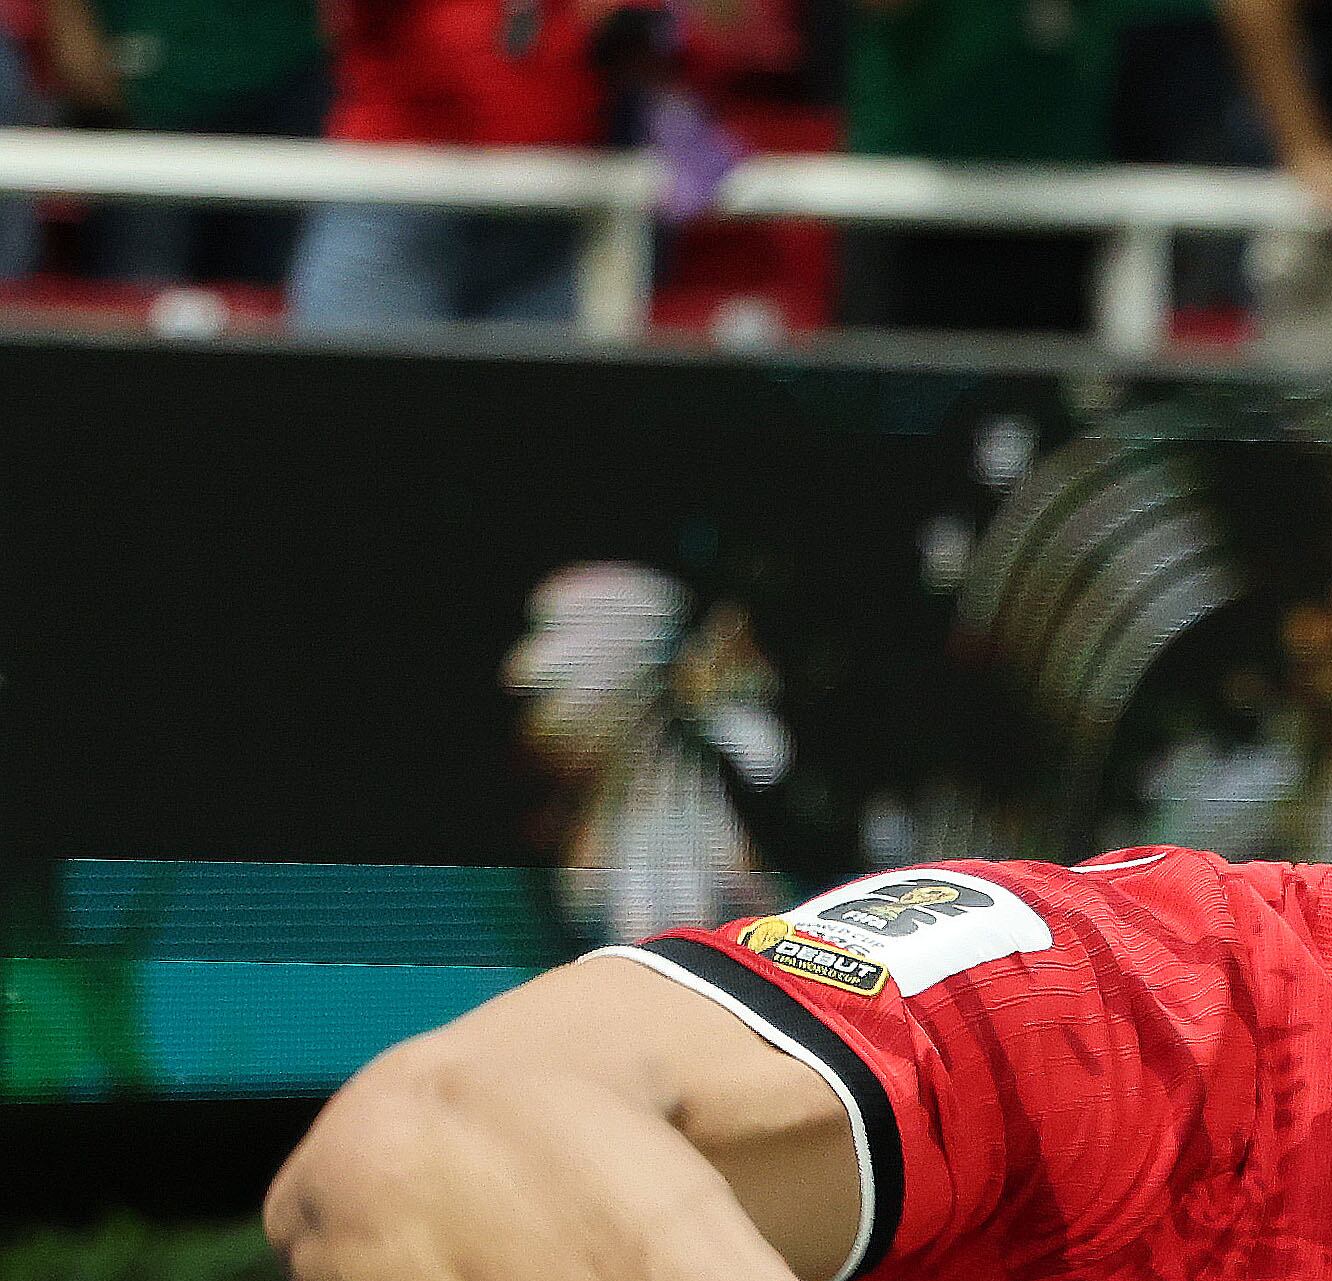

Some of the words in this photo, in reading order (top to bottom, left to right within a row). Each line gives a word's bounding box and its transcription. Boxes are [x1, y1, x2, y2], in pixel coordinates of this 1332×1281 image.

[841, 909, 888, 932] FIFA
[775, 940, 877, 978] DEBUT
[798, 960, 837, 979] WORLD
[838, 970, 862, 985] CUP
